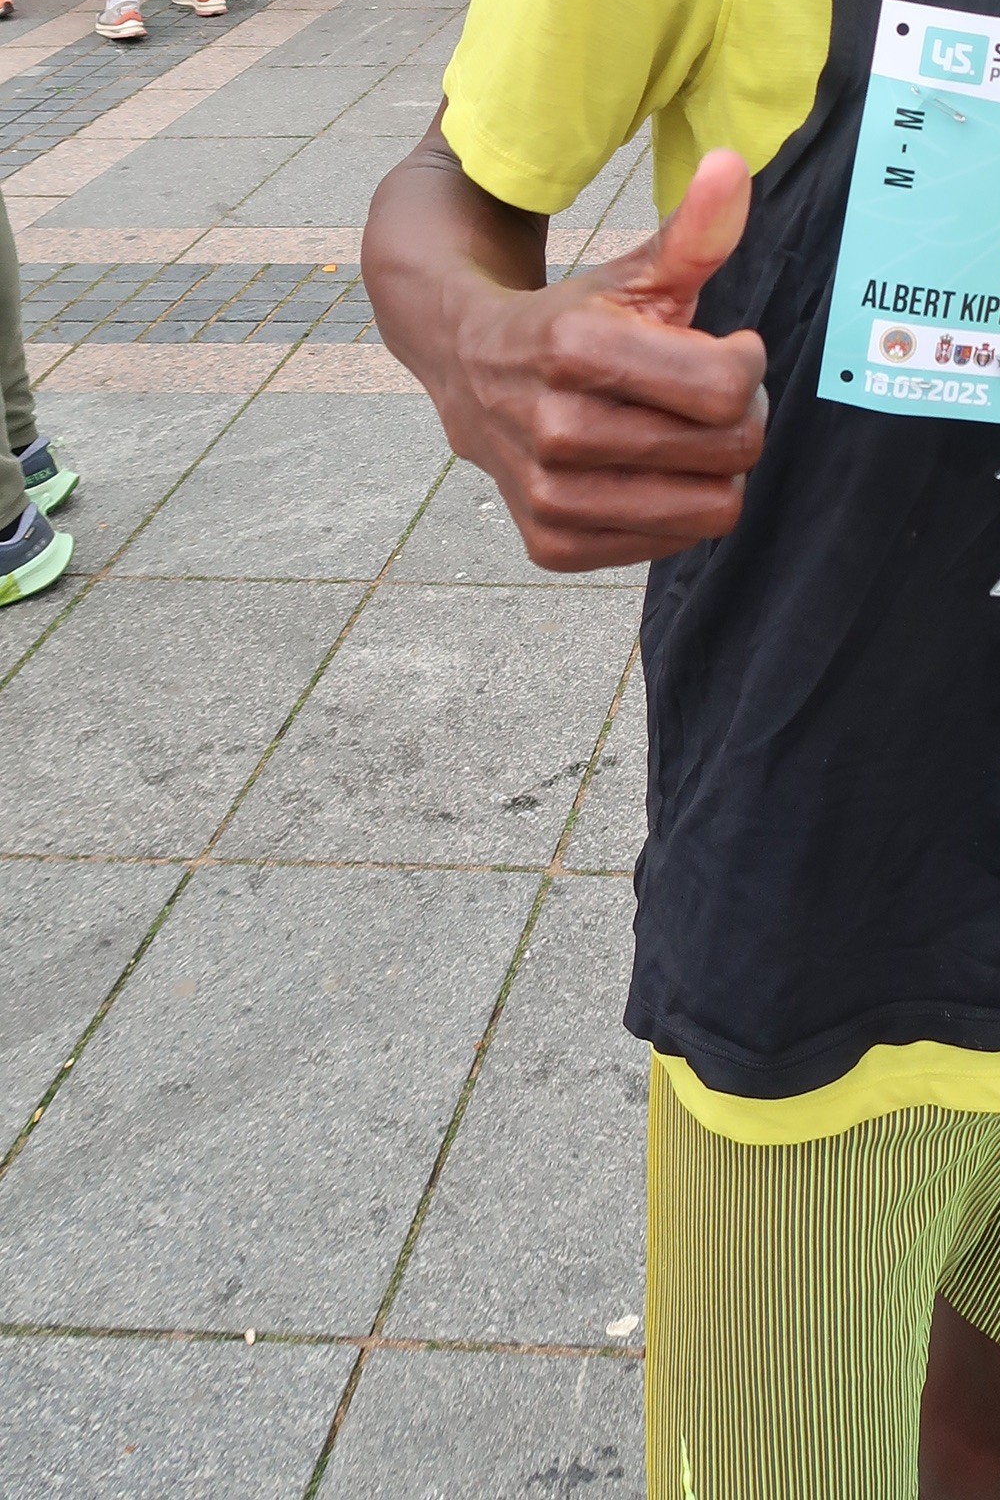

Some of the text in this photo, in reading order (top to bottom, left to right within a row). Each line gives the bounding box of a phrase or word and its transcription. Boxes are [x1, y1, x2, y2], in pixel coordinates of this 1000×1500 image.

[894, 107, 925, 130] M
[884, 166, 915, 189] M
[861, 279, 957, 320] ALBERT
